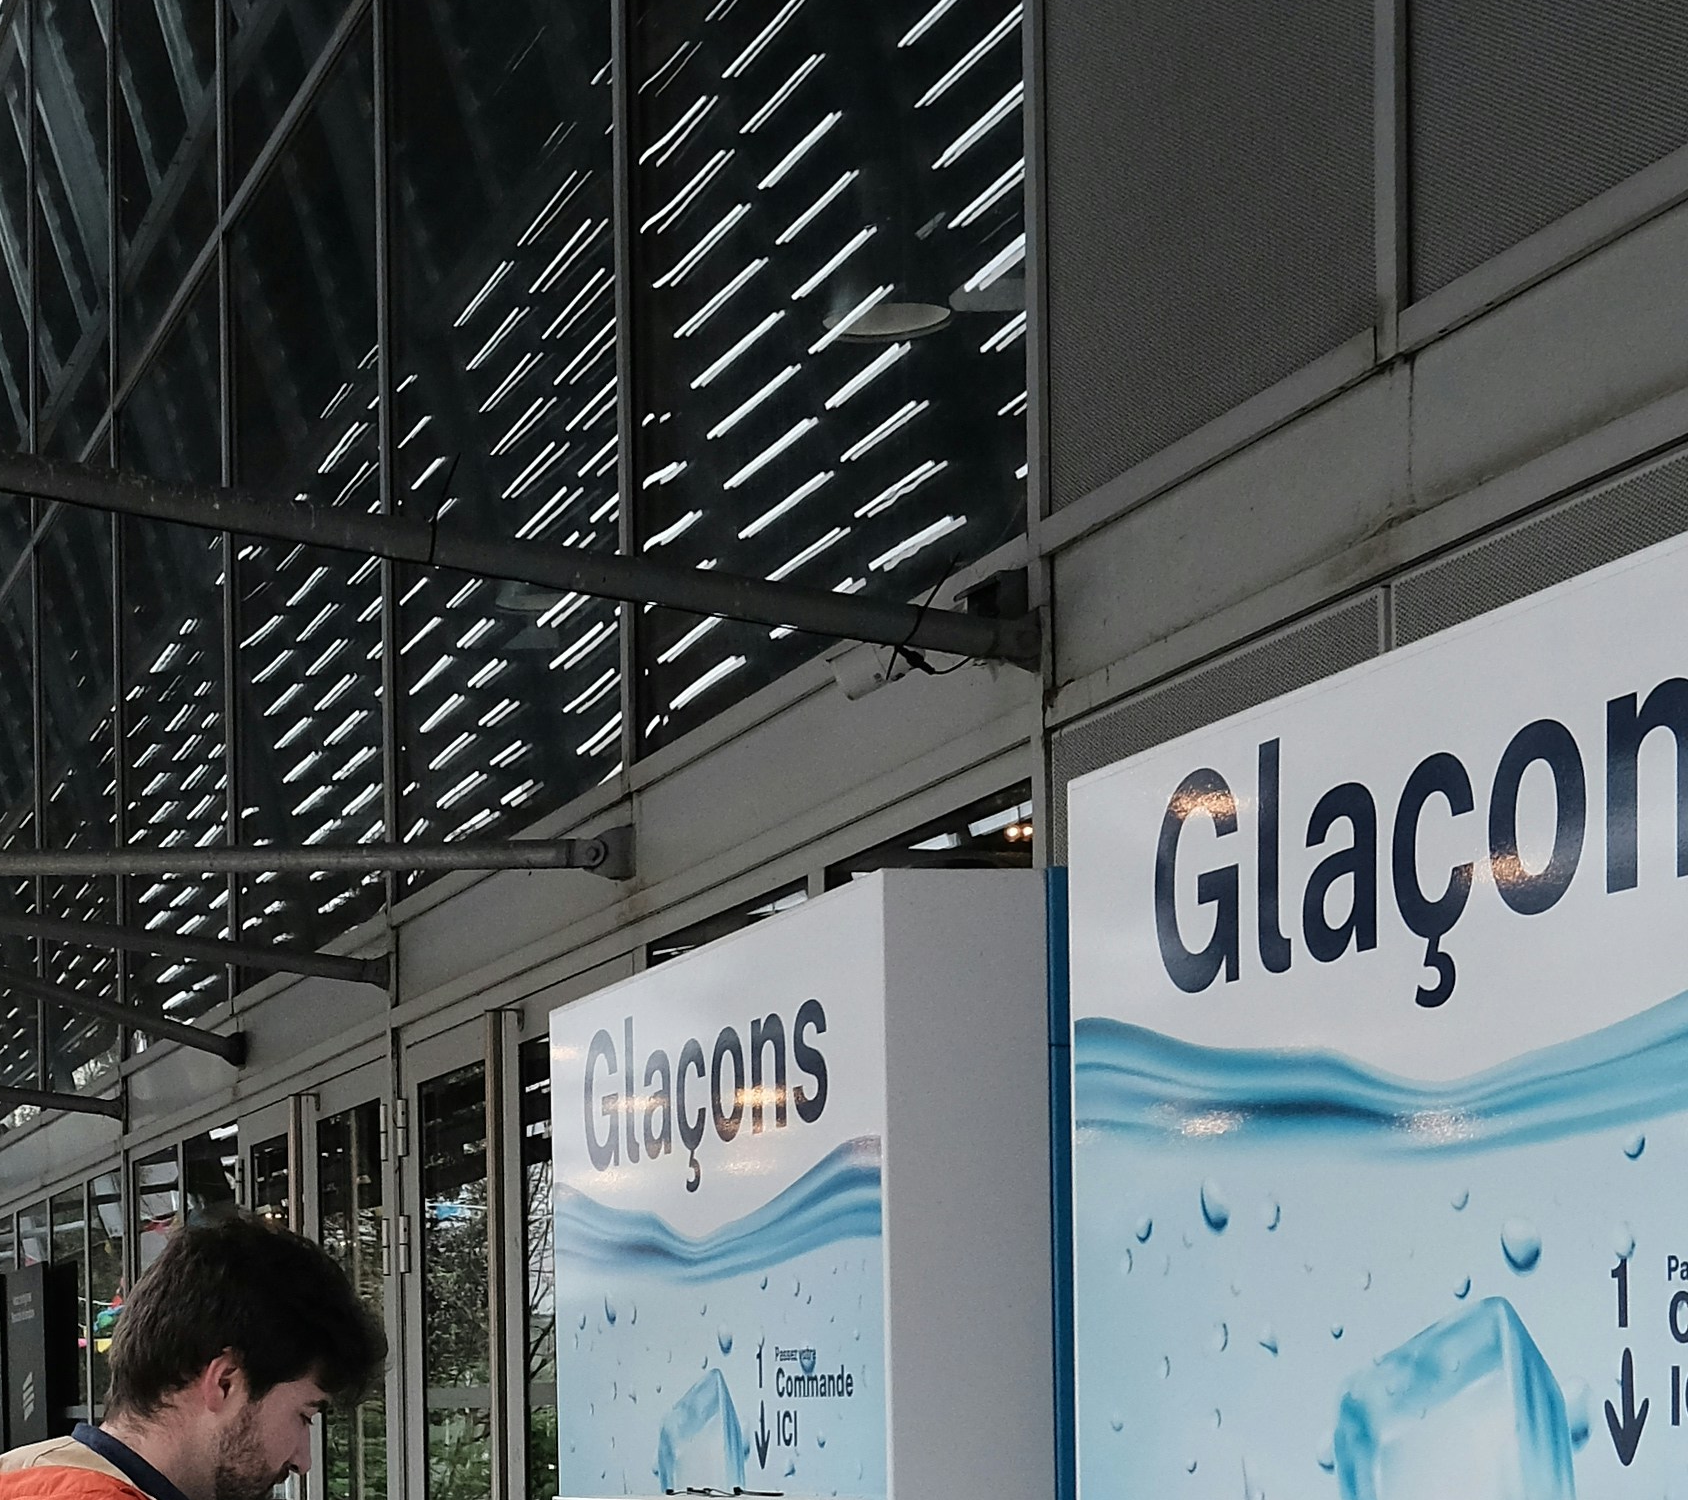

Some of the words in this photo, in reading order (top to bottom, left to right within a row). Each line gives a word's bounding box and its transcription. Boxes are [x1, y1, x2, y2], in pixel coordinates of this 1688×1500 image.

[584, 999, 828, 1192] Glaçons
[776, 1364, 853, 1398] Commande
[777, 1410, 797, 1447] ICI
